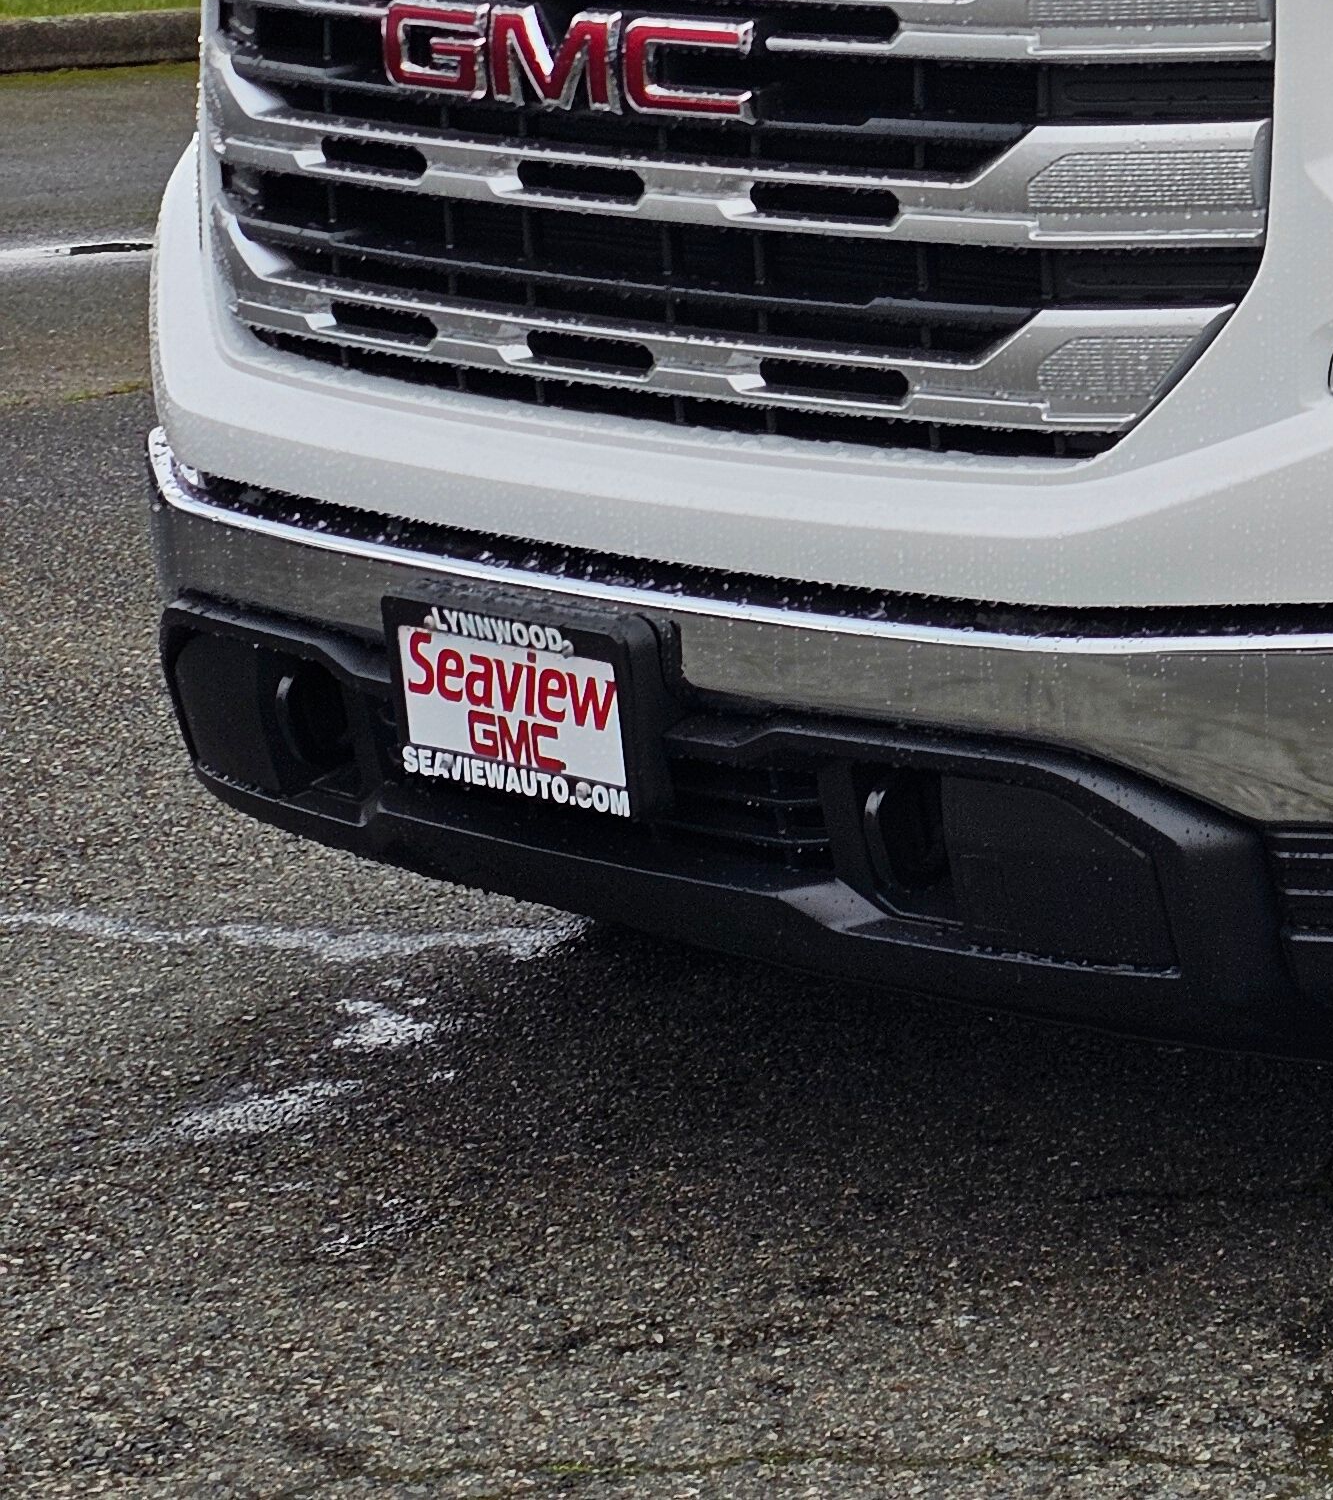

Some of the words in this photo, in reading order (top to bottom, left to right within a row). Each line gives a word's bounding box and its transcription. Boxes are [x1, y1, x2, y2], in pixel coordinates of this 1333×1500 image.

[431, 606, 564, 652] LYNNWOOD
[408, 631, 616, 731] Seaview
[467, 709, 567, 775] GMC
[402, 745, 631, 818] SEAVIEWAUTO.COM
